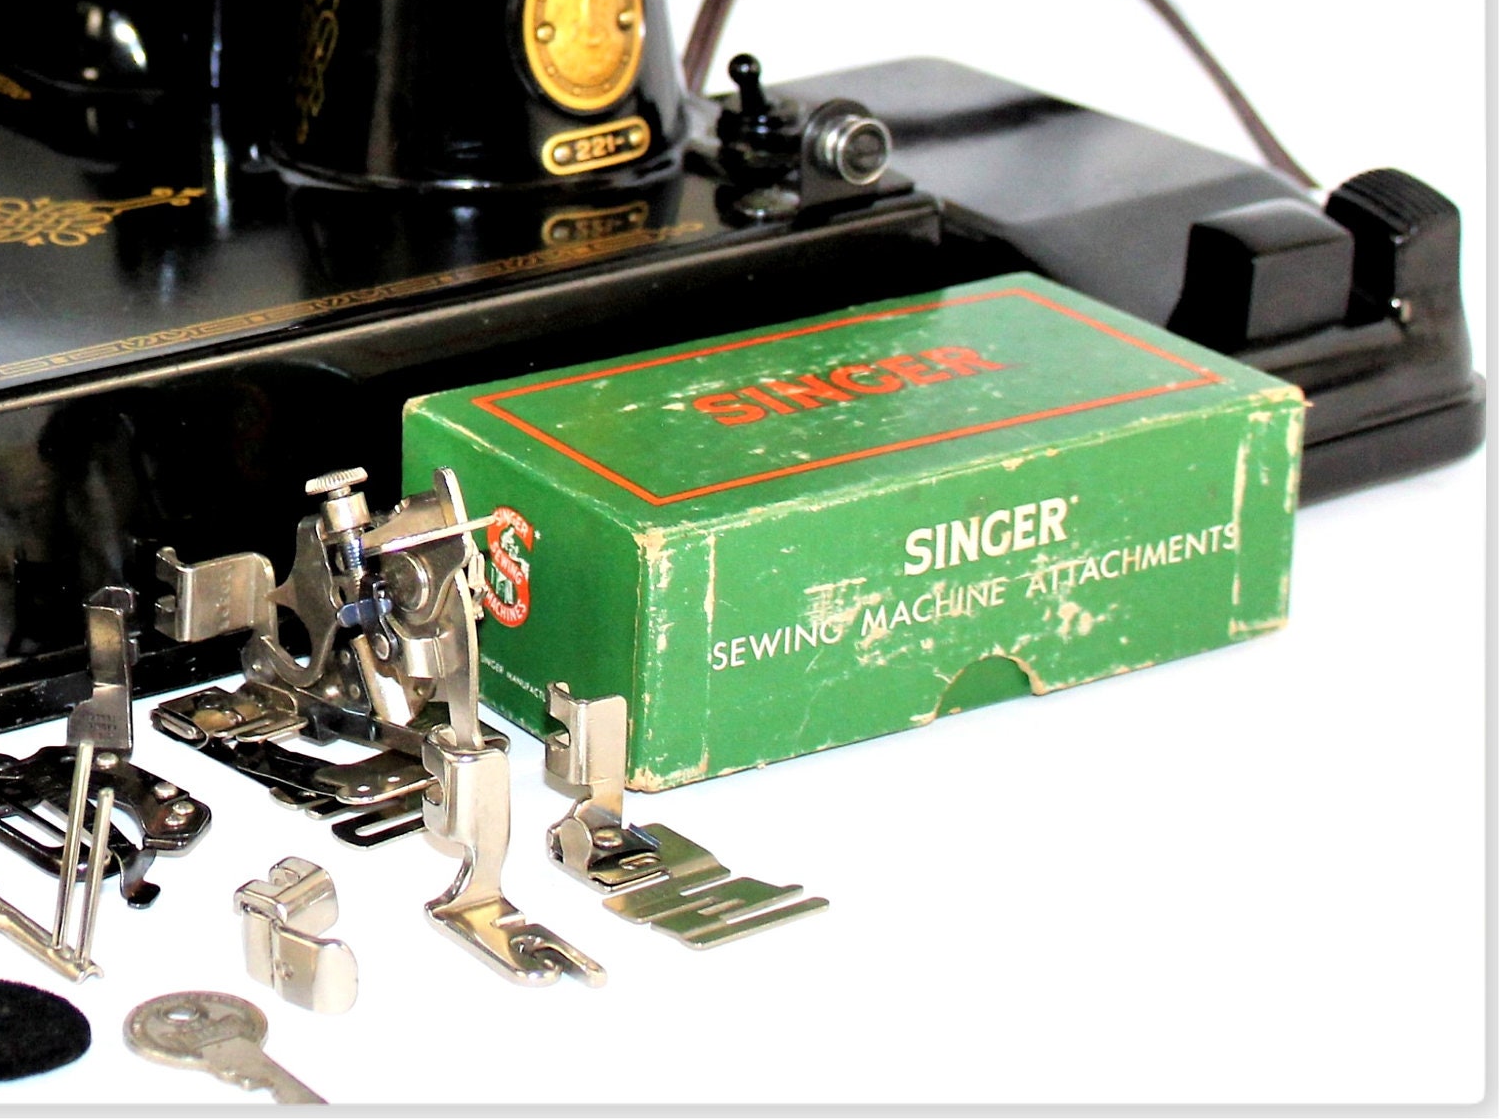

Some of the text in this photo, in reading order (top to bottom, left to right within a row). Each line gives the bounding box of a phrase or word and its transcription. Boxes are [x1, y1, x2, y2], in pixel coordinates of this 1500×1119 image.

[693, 345, 1004, 426] SINGER
[490, 541, 523, 585] SEWING
[903, 496, 1070, 576] SINGER
[711, 521, 1241, 671] SEWING MACHINE ATTACHMENTS
